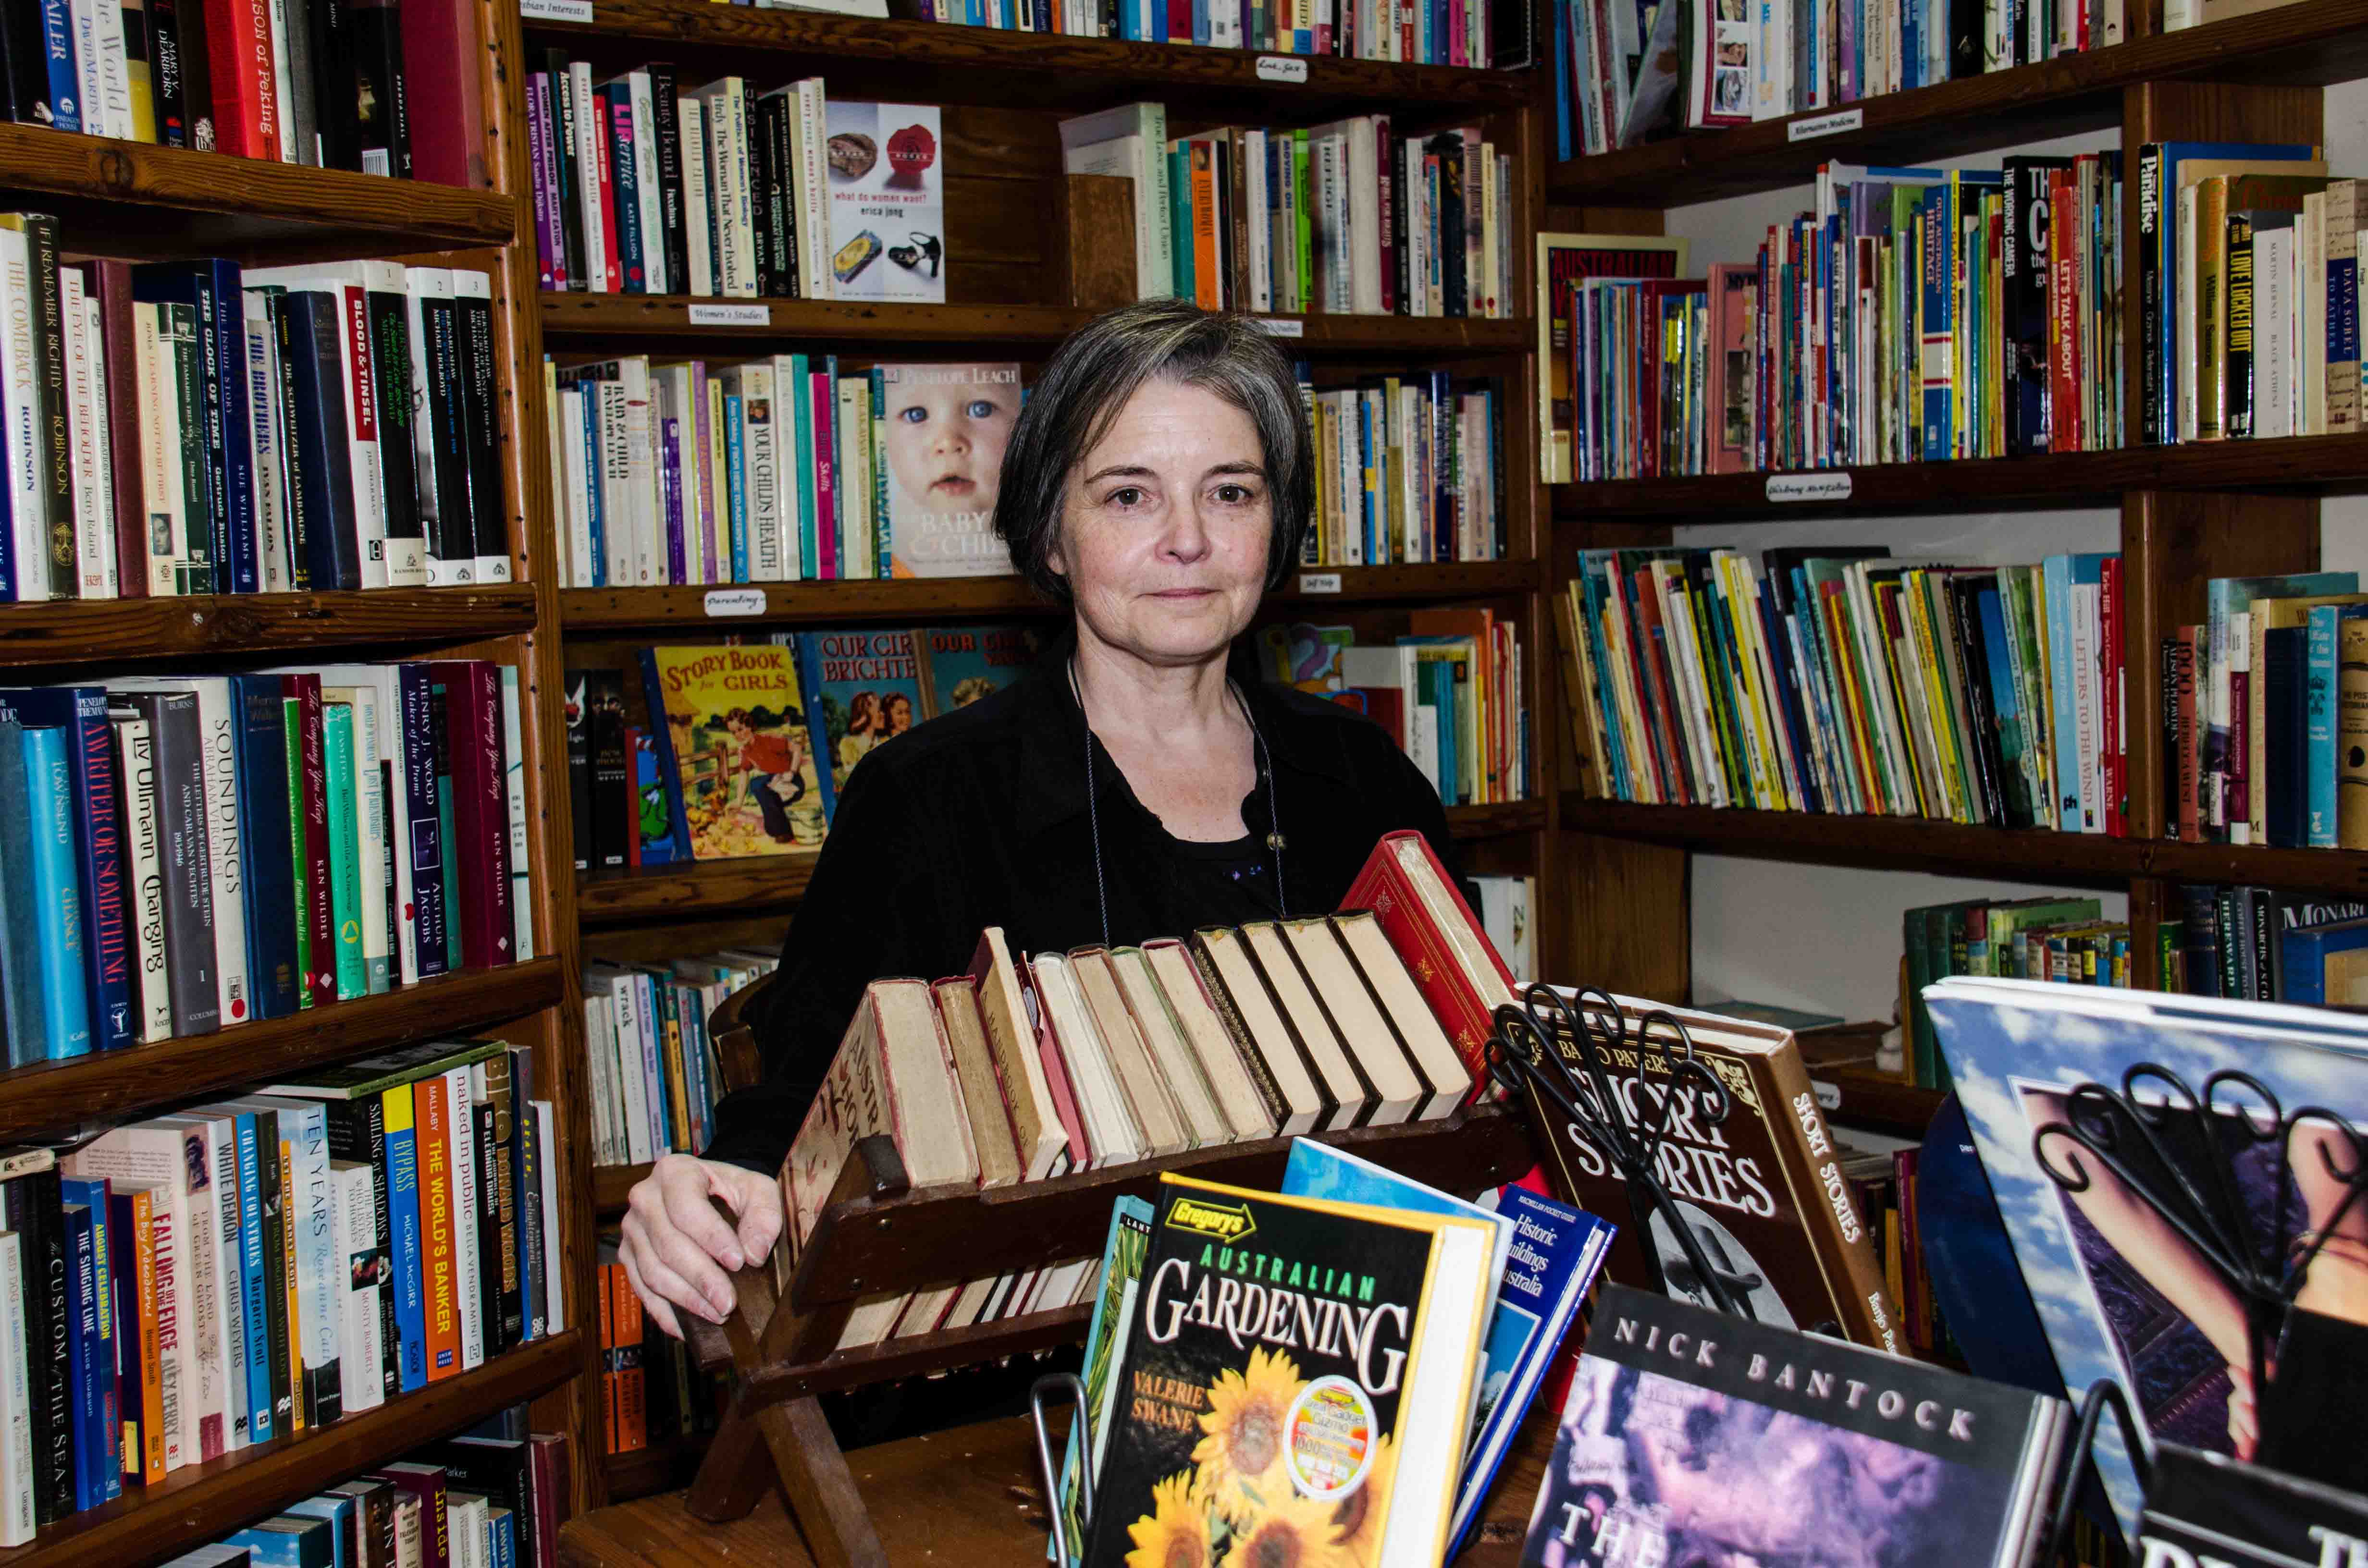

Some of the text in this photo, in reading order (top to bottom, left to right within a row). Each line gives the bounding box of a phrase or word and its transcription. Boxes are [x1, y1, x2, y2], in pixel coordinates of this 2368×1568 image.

[47, 0, 68, 60] AILER
[548, 3, 585, 15] Interests
[102, 35, 129, 112] World
[158, 30, 173, 98] DEARBORN
[167, 42, 179, 91] MARY V.
[256, 45, 268, 67] of
[258, 69, 275, 135] Peking
[525, 86, 536, 118] FLORA
[559, 72, 576, 157] Access to Power
[530, 120, 541, 159] TRISTAN
[541, 86, 561, 246] WOMEN AFTER PRISON MARY EATON
[533, 161, 542, 189] Sandra
[712, 97, 738, 289] Hrdy The Woman That Never Evolved
[836, 192, 857, 201] what
[903, 194, 927, 204] want?
[2140, 156, 2157, 233] Paradise
[626, 203, 638, 260] KATE FILLION
[861, 207, 903, 218] erica jong
[1926, 208, 1935, 285] HERITAGE
[2003, 168, 2016, 277] THE WORKING CAMERA
[42, 249, 58, 327] REMEMBER
[1935, 226, 1943, 294] AUSTRALIAN
[353, 300, 366, 353] BLOOD
[2060, 259, 2072, 379] LET'S TALK ABOUT
[2229, 250, 2252, 353] LOVE LOCKED OUT
[2342, 268, 2353, 355] DAVA SOBEL
[7, 260, 35, 491] THE COMEBACK ROBINSON
[48, 334, 63, 392] RIGHTLY
[200, 290, 221, 449] THE CLOCK OF TIME
[2269, 334, 2278, 368] BLACK
[358, 368, 371, 426] TINSEL
[52, 415, 69, 495] ROBINSON
[614, 386, 629, 480] BABY & CHILD
[754, 427, 773, 462] YOUR
[819, 461, 830, 492] Skills
[759, 515, 777, 569] HEALTH
[667, 649, 783, 692] STORY BOOK
[723, 674, 789, 691] GIRLS
[419, 678, 435, 805] HENRY J. WOOD
[2075, 637, 2093, 803] LETTERS TO THE WIND
[214, 719, 242, 894] SOUNDINGS
[2105, 767, 2114, 811] WARNE
[83, 722, 126, 985] A WRITER OR SOMETHING
[133, 736, 166, 973] Liv Ullmann Changing
[495, 860, 505, 906] WILDER
[2222, 900, 2234, 987] HEREWARD
[619, 985, 633, 1028] wrack
[1792, 1092, 1830, 1157] SHORT
[218, 1142, 238, 1245] WHITE DEMON
[241, 1128, 262, 1268] CHANGING COUNTRIES
[306, 1110, 328, 1237] TEN YEARS
[394, 1140, 415, 1192] BYPASS
[1568, 1122, 1776, 1218] SRIES
[428, 1086, 451, 1334] MALLABY THE WORLD'S BANKER
[456, 1076, 479, 1339] naked in public BELLA VENDRAMINI
[1124, 1217, 1150, 1233] LANT
[1174, 1202, 1245, 1233] Gregory's
[1514, 1213, 1558, 1247] Historic
[1518, 1194, 1545, 1213] MACMILLAN
[1820, 1161, 1861, 1244] STORIES
[77, 1229, 97, 1335] THE SINGING LINE
[94, 1224, 112, 1340] AUGUST CELEBRATION
[1200, 1243, 1375, 1301] AUSTRALIAN
[1501, 1267, 1544, 1298] ustralia
[1506, 1238, 1550, 1273] uildings
[152, 1213, 181, 1438] FALLING EDGE ALEX PERRY
[1145, 1258, 1410, 1396] GARDENING
[1867, 1291, 1886, 1330] Banjo
[49, 1258, 68, 1482] CUSTOM THE SEA
[1133, 1370, 1207, 1406] VALERIE
[1614, 1316, 1975, 1443] NICK BANTOCK
[1132, 1399, 1198, 1432] SWANE
[434, 1487, 447, 1558] Inside
